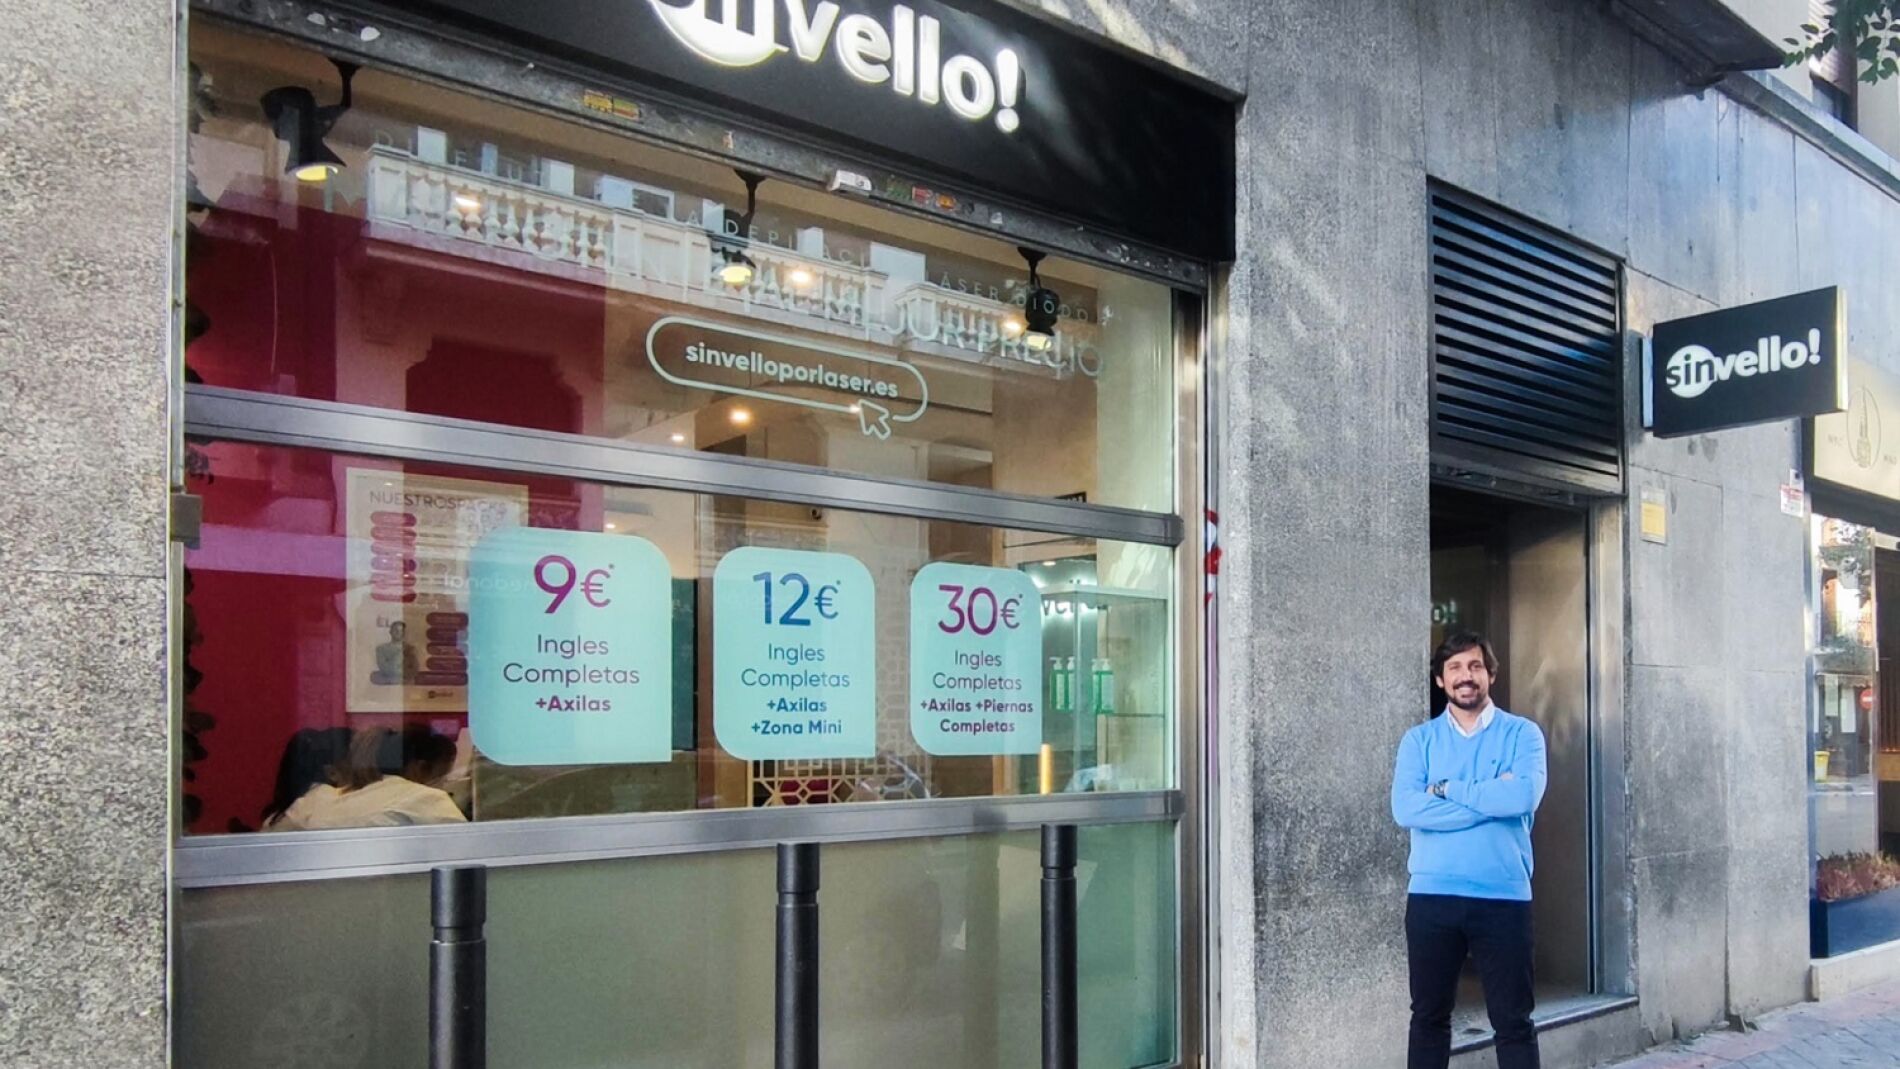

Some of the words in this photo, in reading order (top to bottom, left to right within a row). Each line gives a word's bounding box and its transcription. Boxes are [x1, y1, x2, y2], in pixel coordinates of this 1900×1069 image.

[686, 342, 898, 398] sinvelloporlaser.es
[1666, 328, 1820, 392] sinvello!
[537, 634, 609, 660] Ingles
[768, 643, 825, 666] Ingles
[954, 650, 1002, 670] Ingles
[503, 662, 640, 688] Completas
[741, 668, 850, 691] Completas
[932, 672, 1022, 692] Completas
[535, 695, 612, 712] +Axilas
[766, 697, 827, 713] +Axilas
[920, 698, 972, 713] +Axilas
[976, 698, 1034, 713] +Piernas
[751, 720, 803, 736] +Zona
[808, 720, 842, 735] Mini
[940, 718, 1016, 735] Completas
